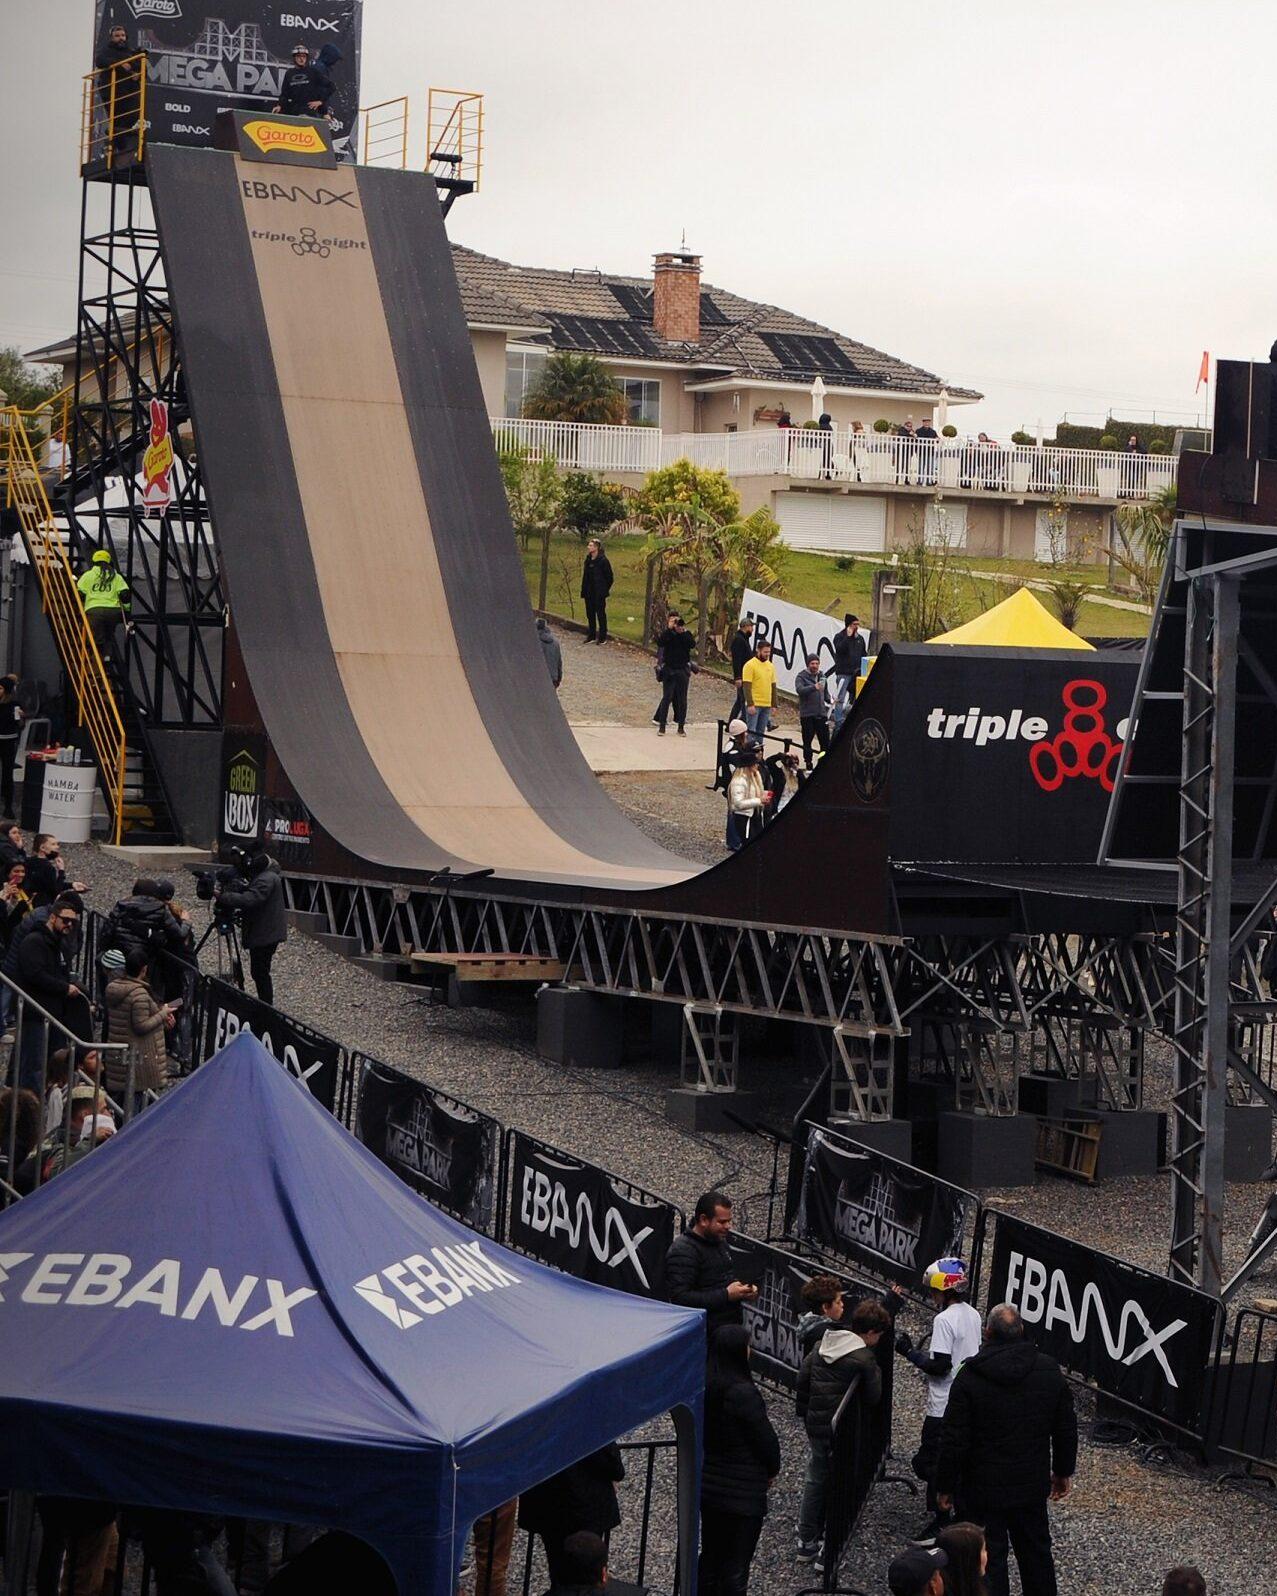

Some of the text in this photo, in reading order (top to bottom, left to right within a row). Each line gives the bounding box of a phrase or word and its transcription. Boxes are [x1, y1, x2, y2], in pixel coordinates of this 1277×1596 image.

[280, 13, 339, 32] EBANX
[147, 55, 286, 96] MEGA PA
[165, 102, 191, 113] BOLD
[172, 123, 211, 136] EBANX
[256, 125, 315, 145] Garoto
[242, 180, 358, 208] EBANX
[251, 229, 367, 249] triple eight
[927, 707, 1048, 746] triple
[47, 780, 80, 791] MAMBA
[230, 765, 256, 793] GREEN
[48, 791, 76, 803] WATER
[229, 793, 255, 831] BOX
[386, 1129, 421, 1170] MEGA
[521, 1165, 654, 1289] EBANX
[835, 1202, 919, 1268] MEGA PARK
[381, 1241, 522, 1315] EBANX
[21, 1252, 318, 1338] EBANX
[1005, 1250, 1188, 1388] EBANX
